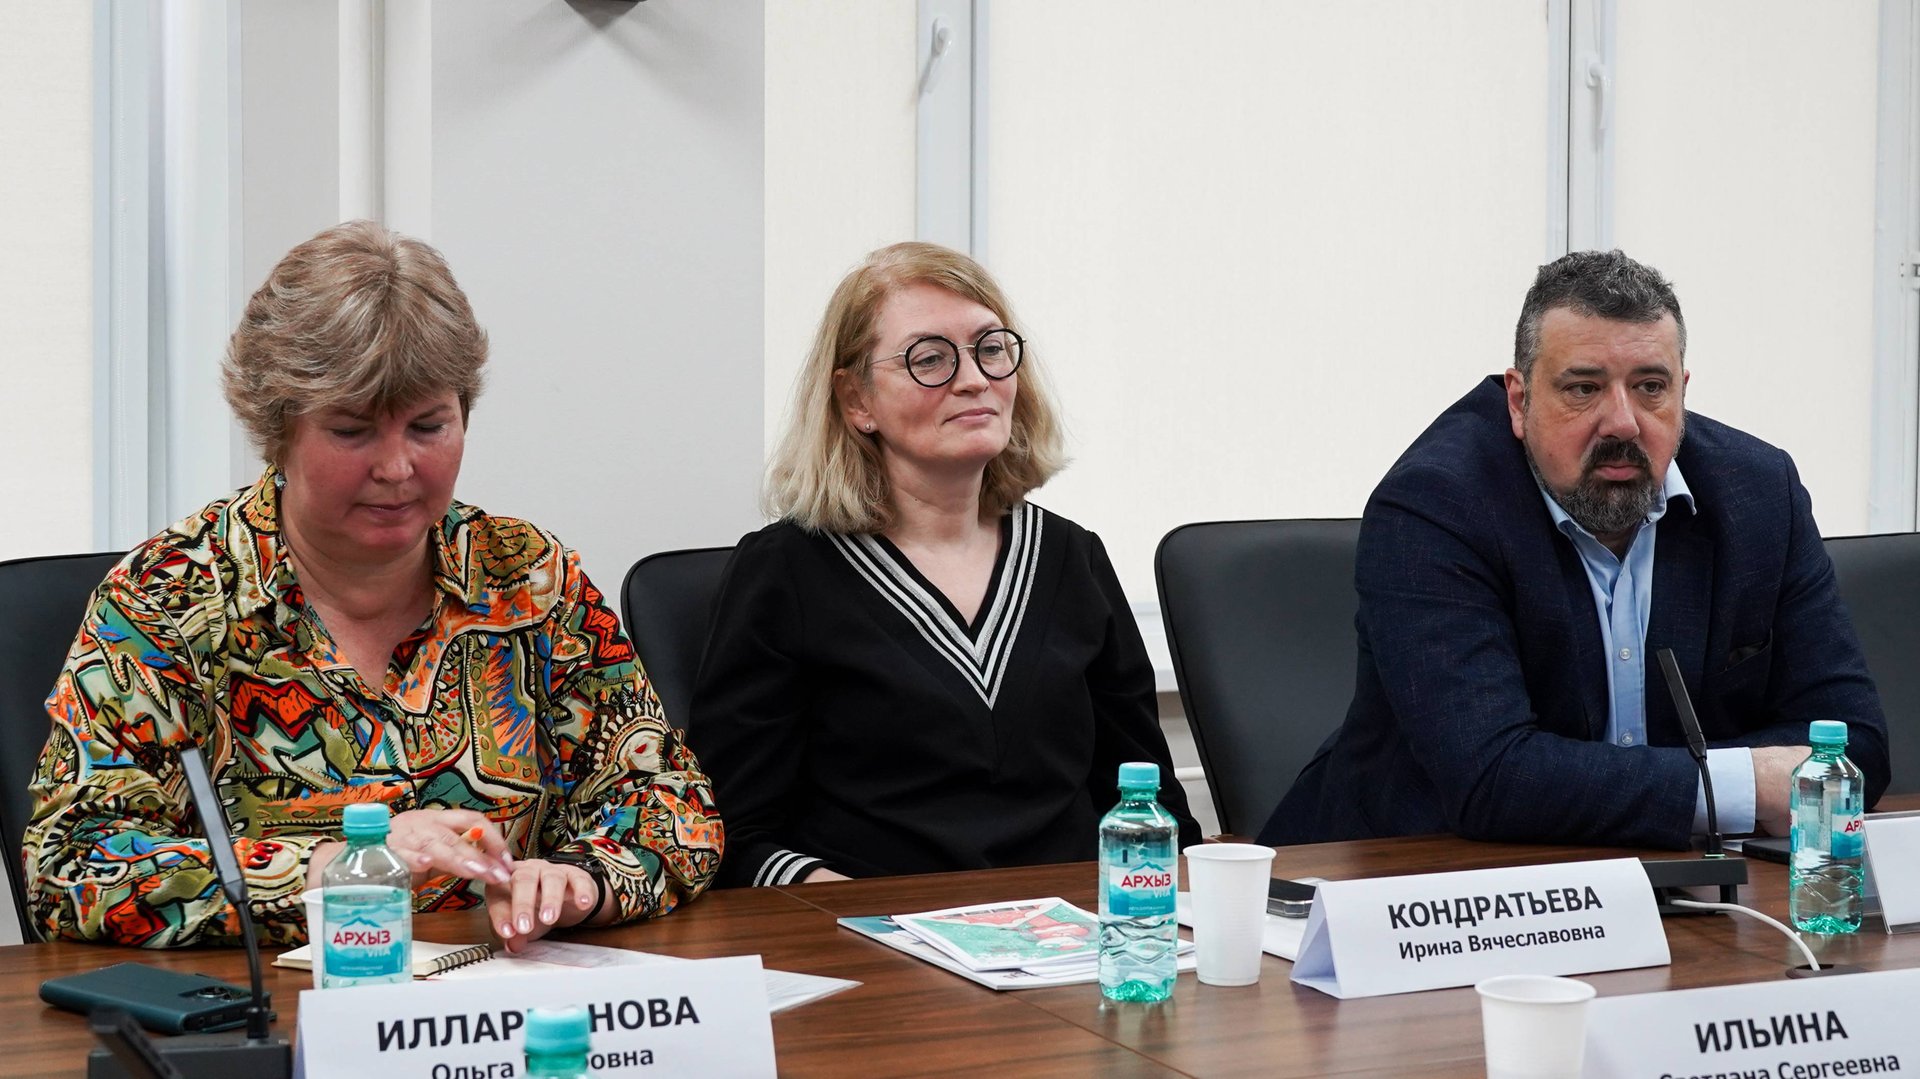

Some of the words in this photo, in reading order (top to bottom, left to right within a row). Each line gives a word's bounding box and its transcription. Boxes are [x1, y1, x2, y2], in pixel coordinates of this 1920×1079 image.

[1121, 873, 1171, 888] АРХЫЗ
[1388, 885, 1603, 929] КОНДРАТЬЕВА
[333, 930, 391, 945] АРХЫЗ
[1399, 939, 1463, 962] Ирина
[1467, 925, 1606, 952] Вячеславовна
[377, 996, 700, 1051] ИЛЛАРНОВА
[1694, 1010, 1848, 1053] ИЛЬИНА
[432, 1062, 514, 1079] Ольга
[1777, 1055, 1901, 1079] Сергеевна
